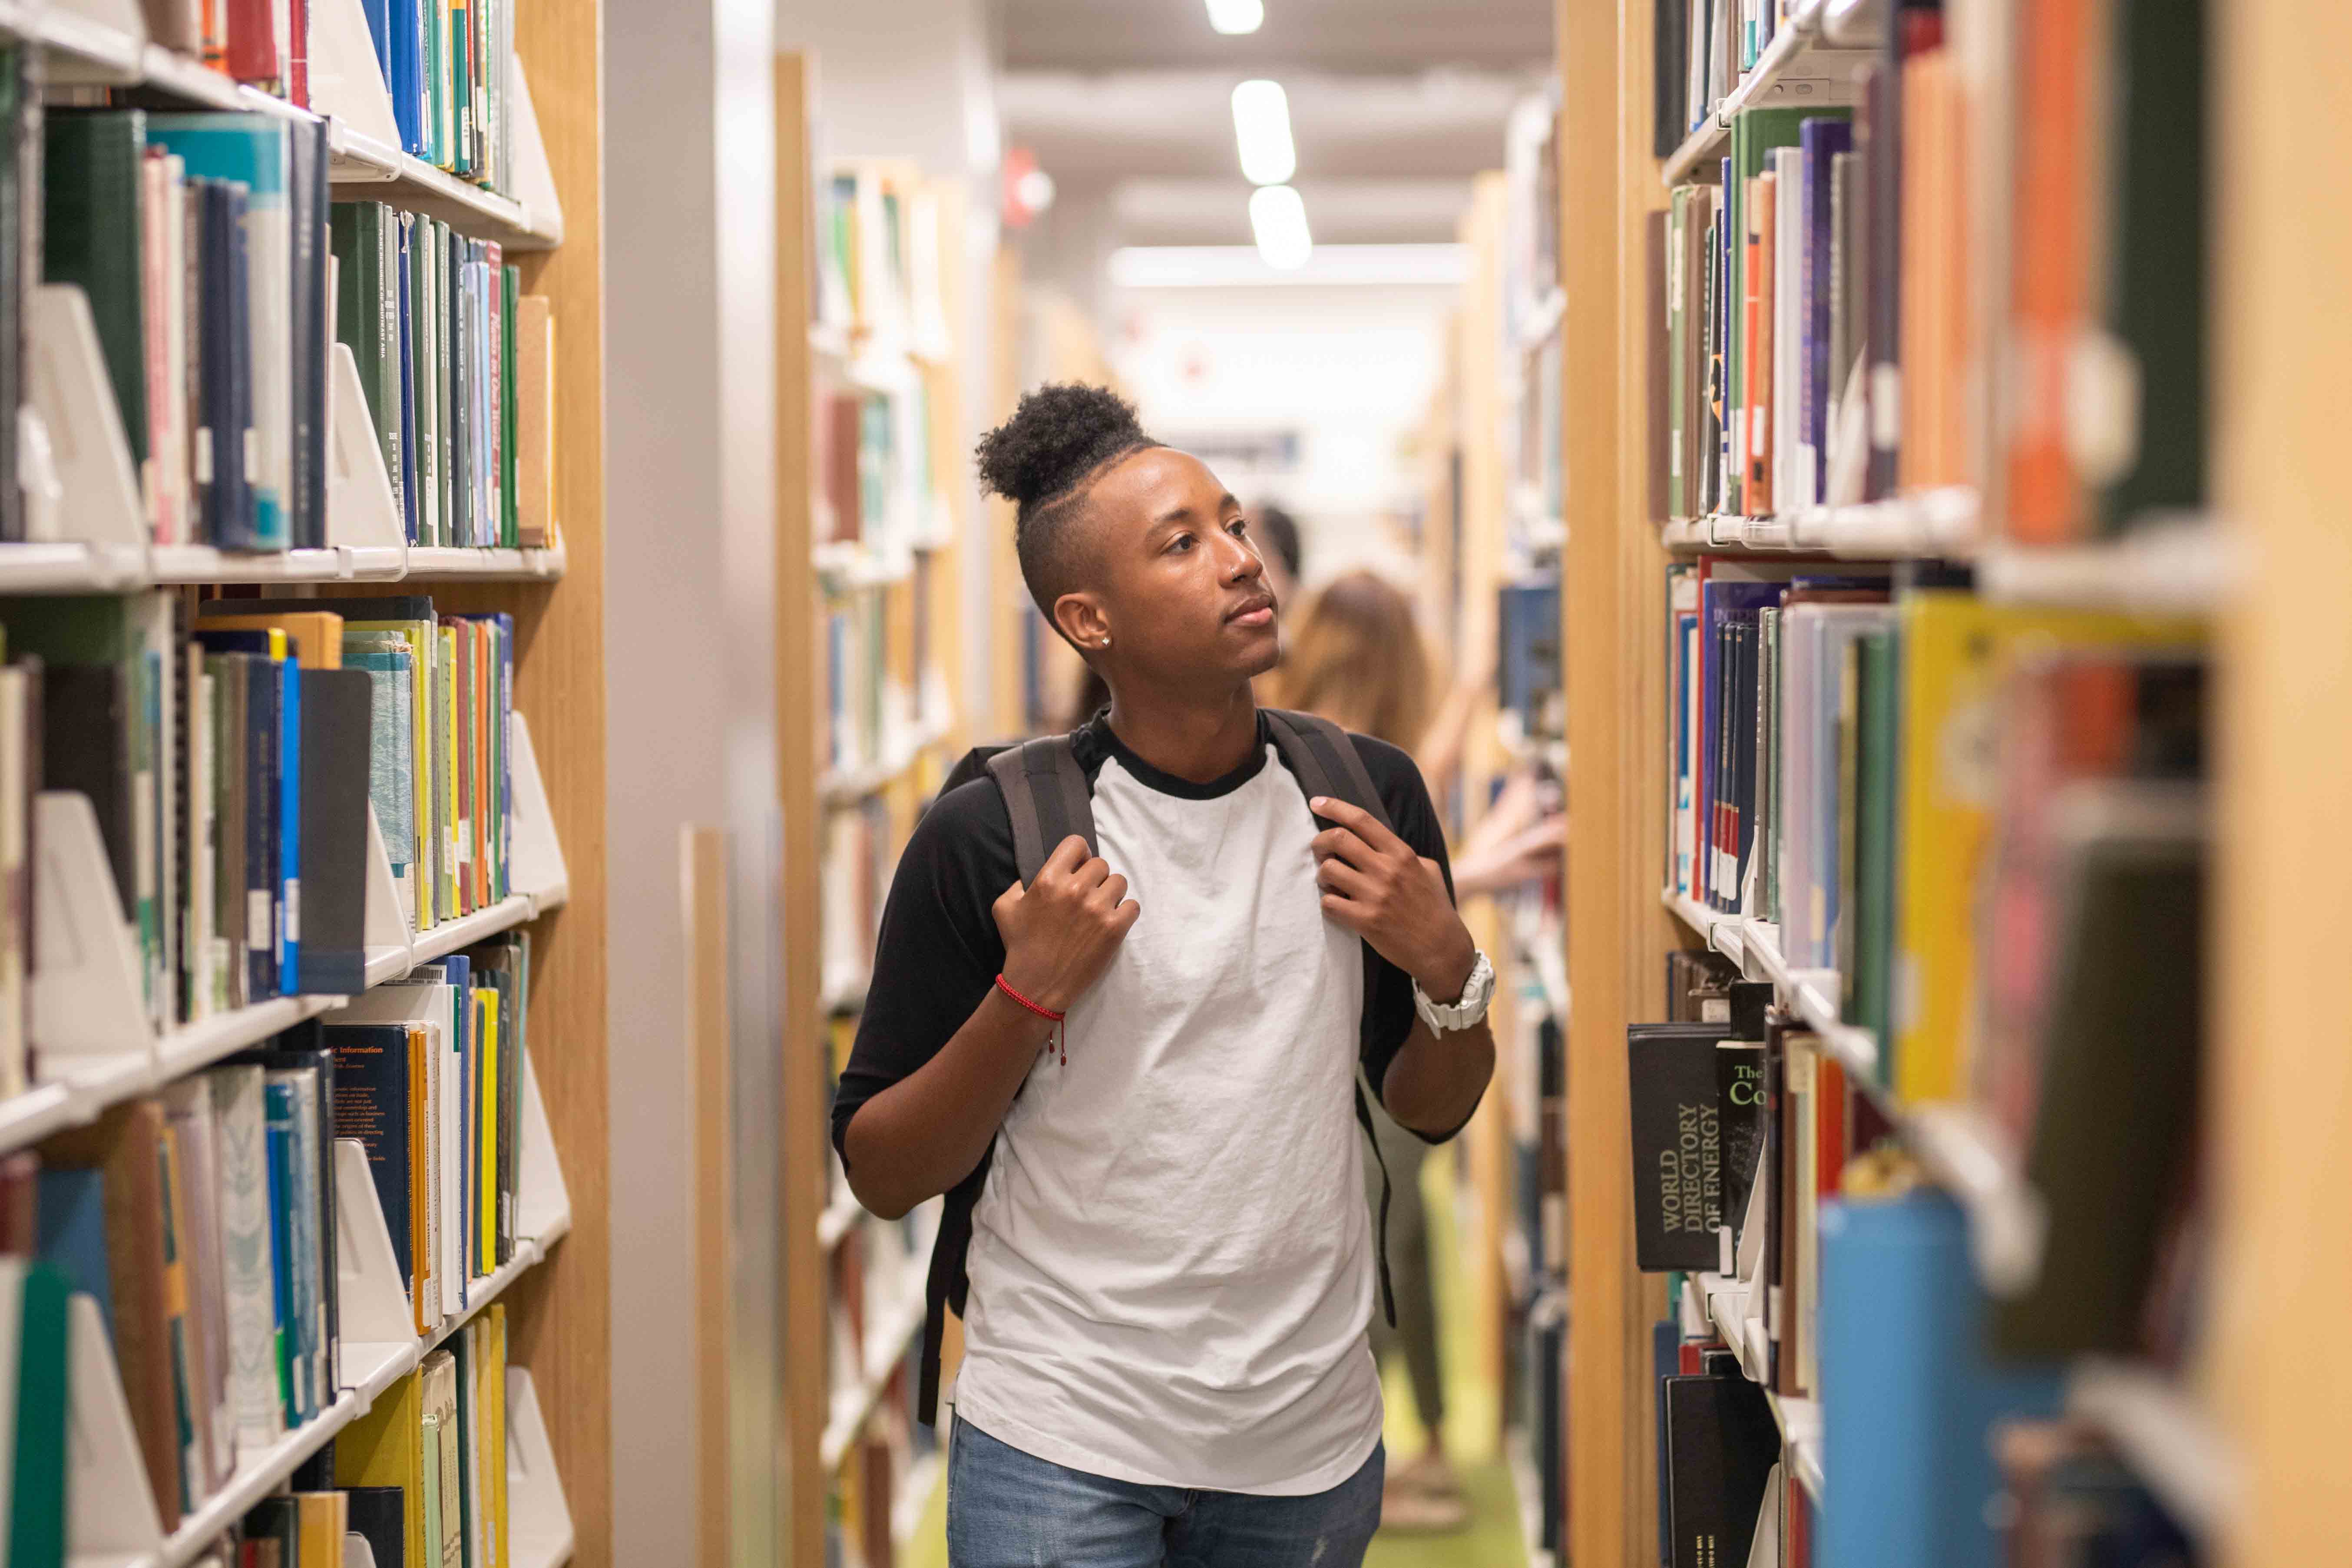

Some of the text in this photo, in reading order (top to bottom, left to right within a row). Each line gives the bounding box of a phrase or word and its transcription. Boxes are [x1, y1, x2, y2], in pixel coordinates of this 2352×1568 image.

[1735, 1065, 1763, 1080] The
[1659, 1150, 1681, 1233] WORLD
[1678, 1103, 1703, 1233] DIRECTORY
[1700, 1103, 1721, 1234] OF ENERGY
